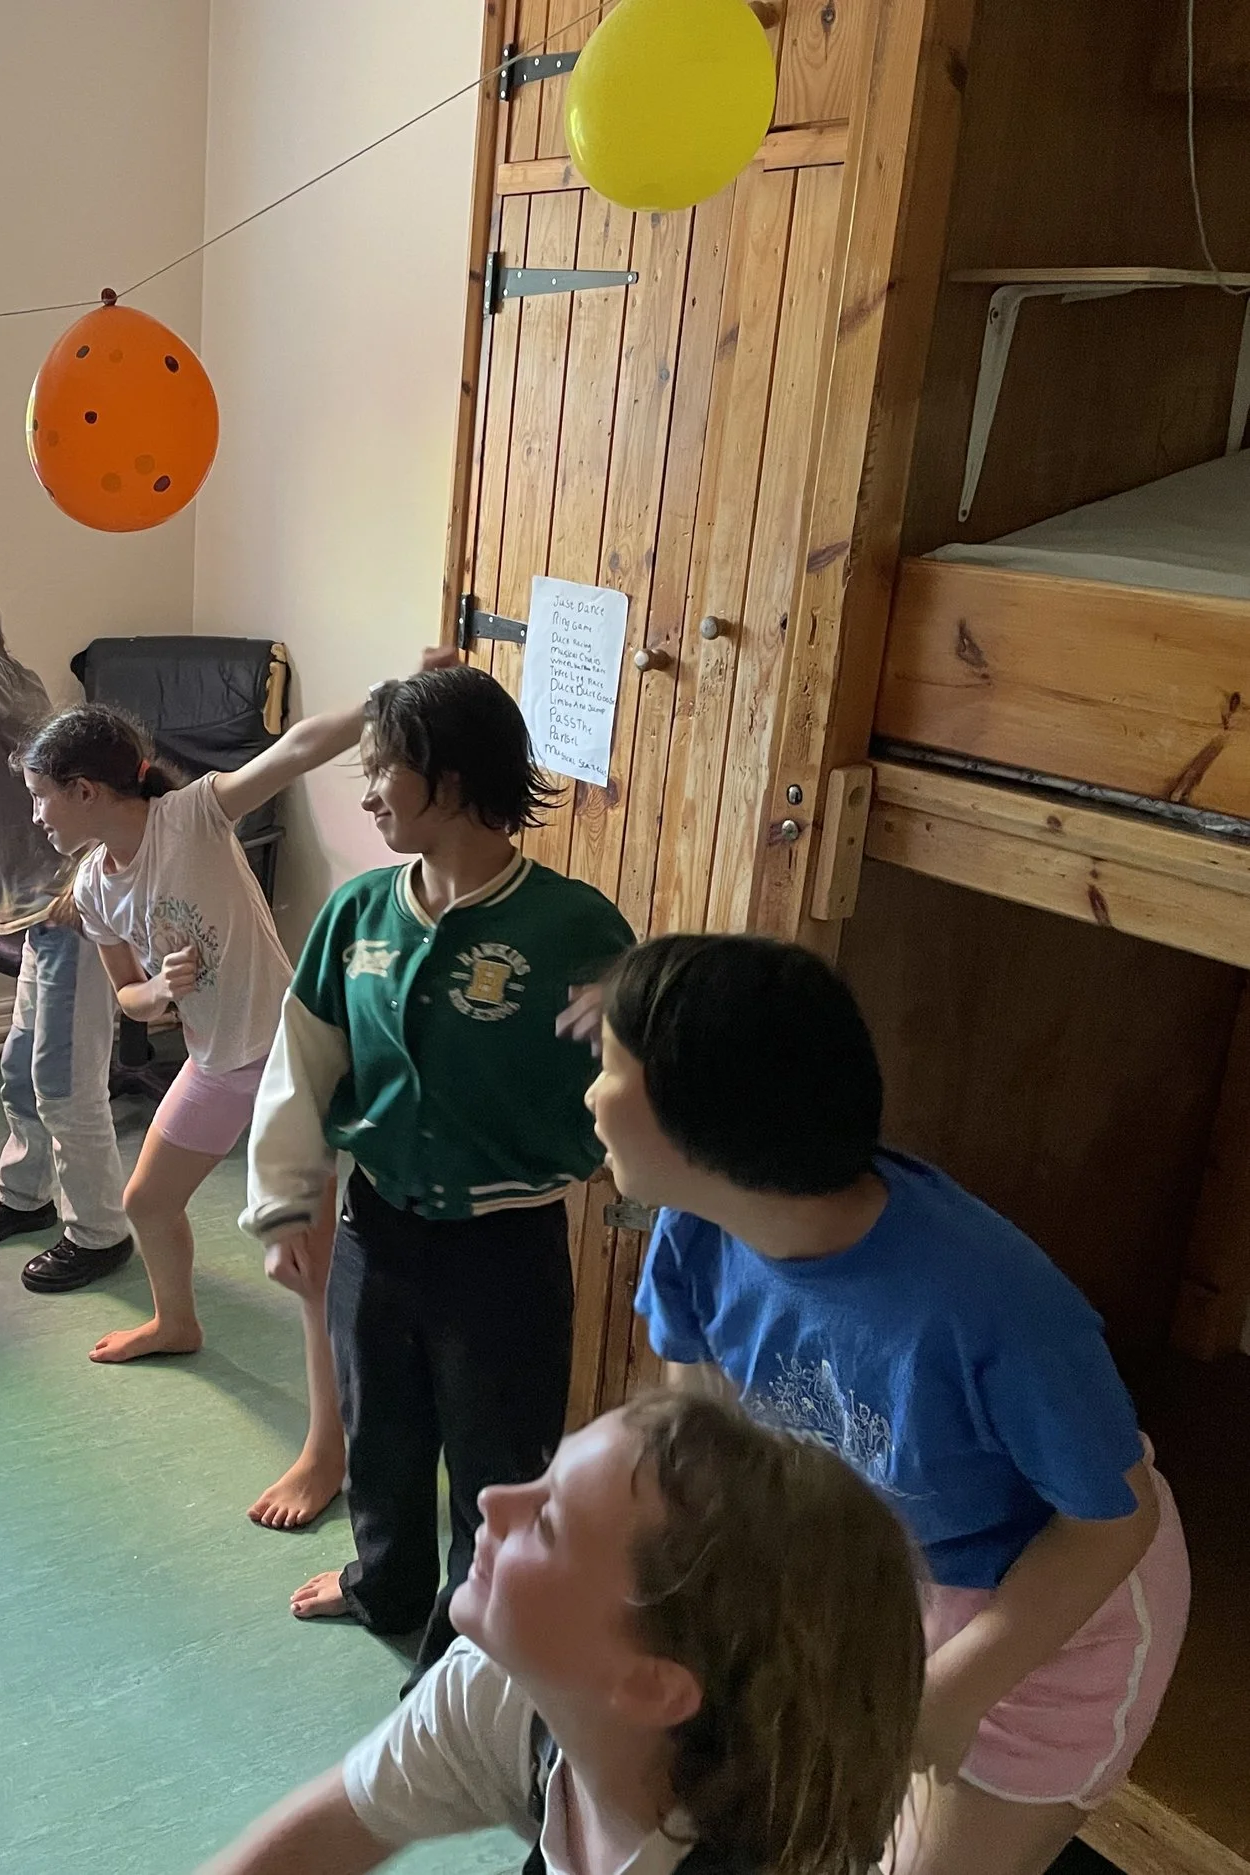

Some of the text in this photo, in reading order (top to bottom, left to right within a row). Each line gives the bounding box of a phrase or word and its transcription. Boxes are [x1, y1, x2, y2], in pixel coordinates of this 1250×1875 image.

[553, 595, 605, 616] Just Dance
[572, 622, 592, 633] Game
[550, 677, 574, 694] Duck
[549, 706, 592, 736] Pass The
